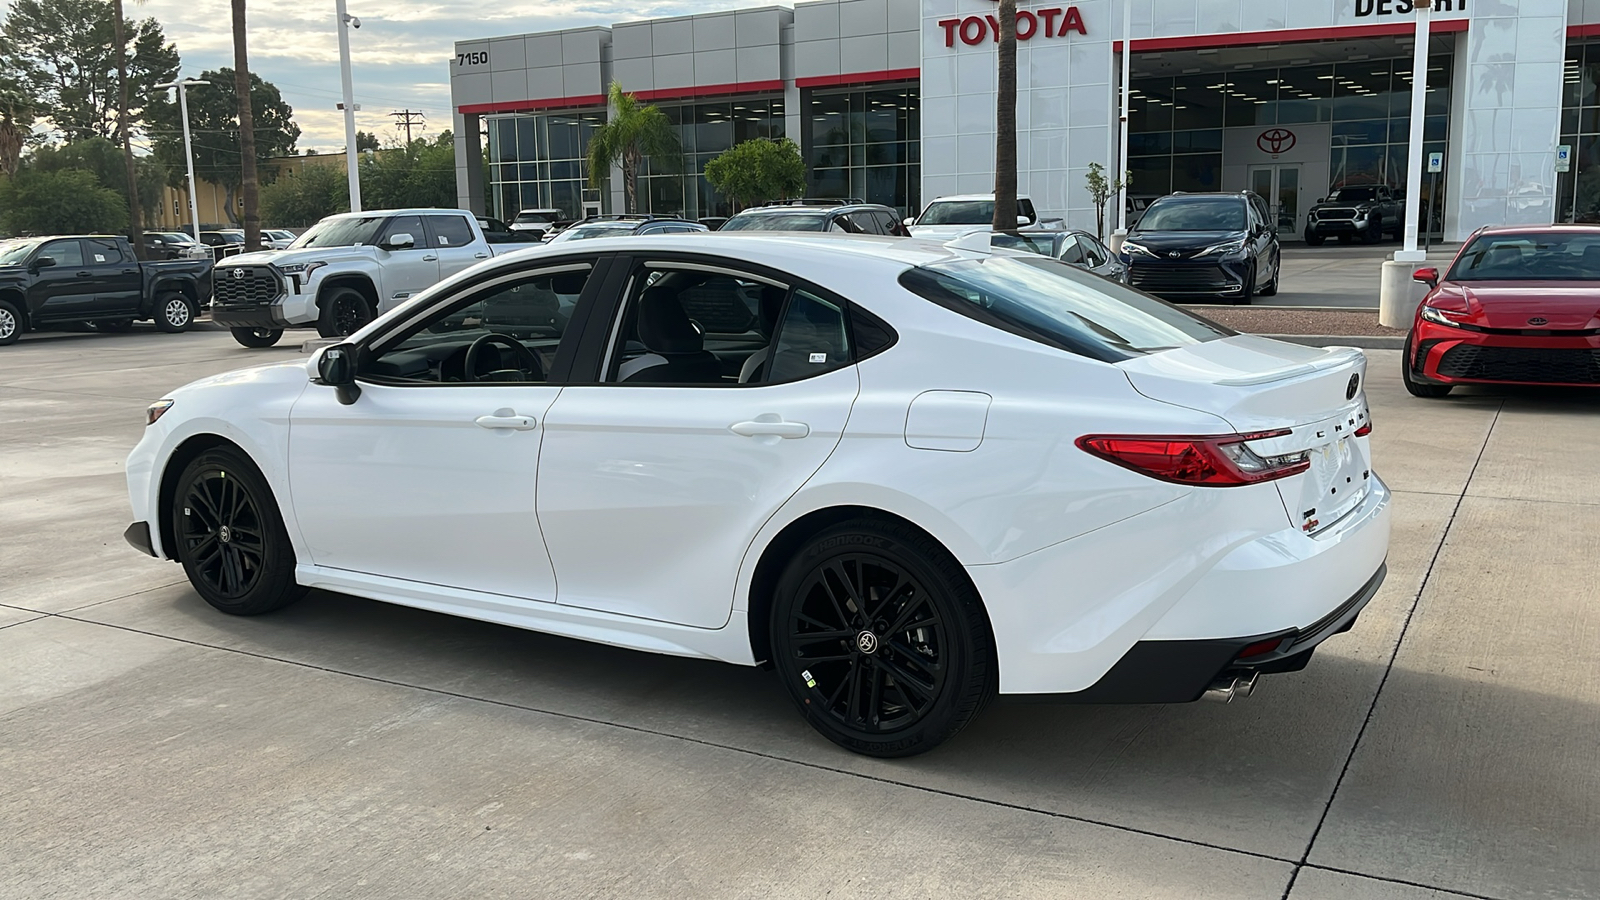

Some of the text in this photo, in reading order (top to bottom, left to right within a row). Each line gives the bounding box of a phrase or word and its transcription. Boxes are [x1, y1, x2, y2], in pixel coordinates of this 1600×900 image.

[1355, 0, 1466, 17] DES
[938, 6, 1087, 47] TOYOTA
[457, 51, 488, 66] 7150
